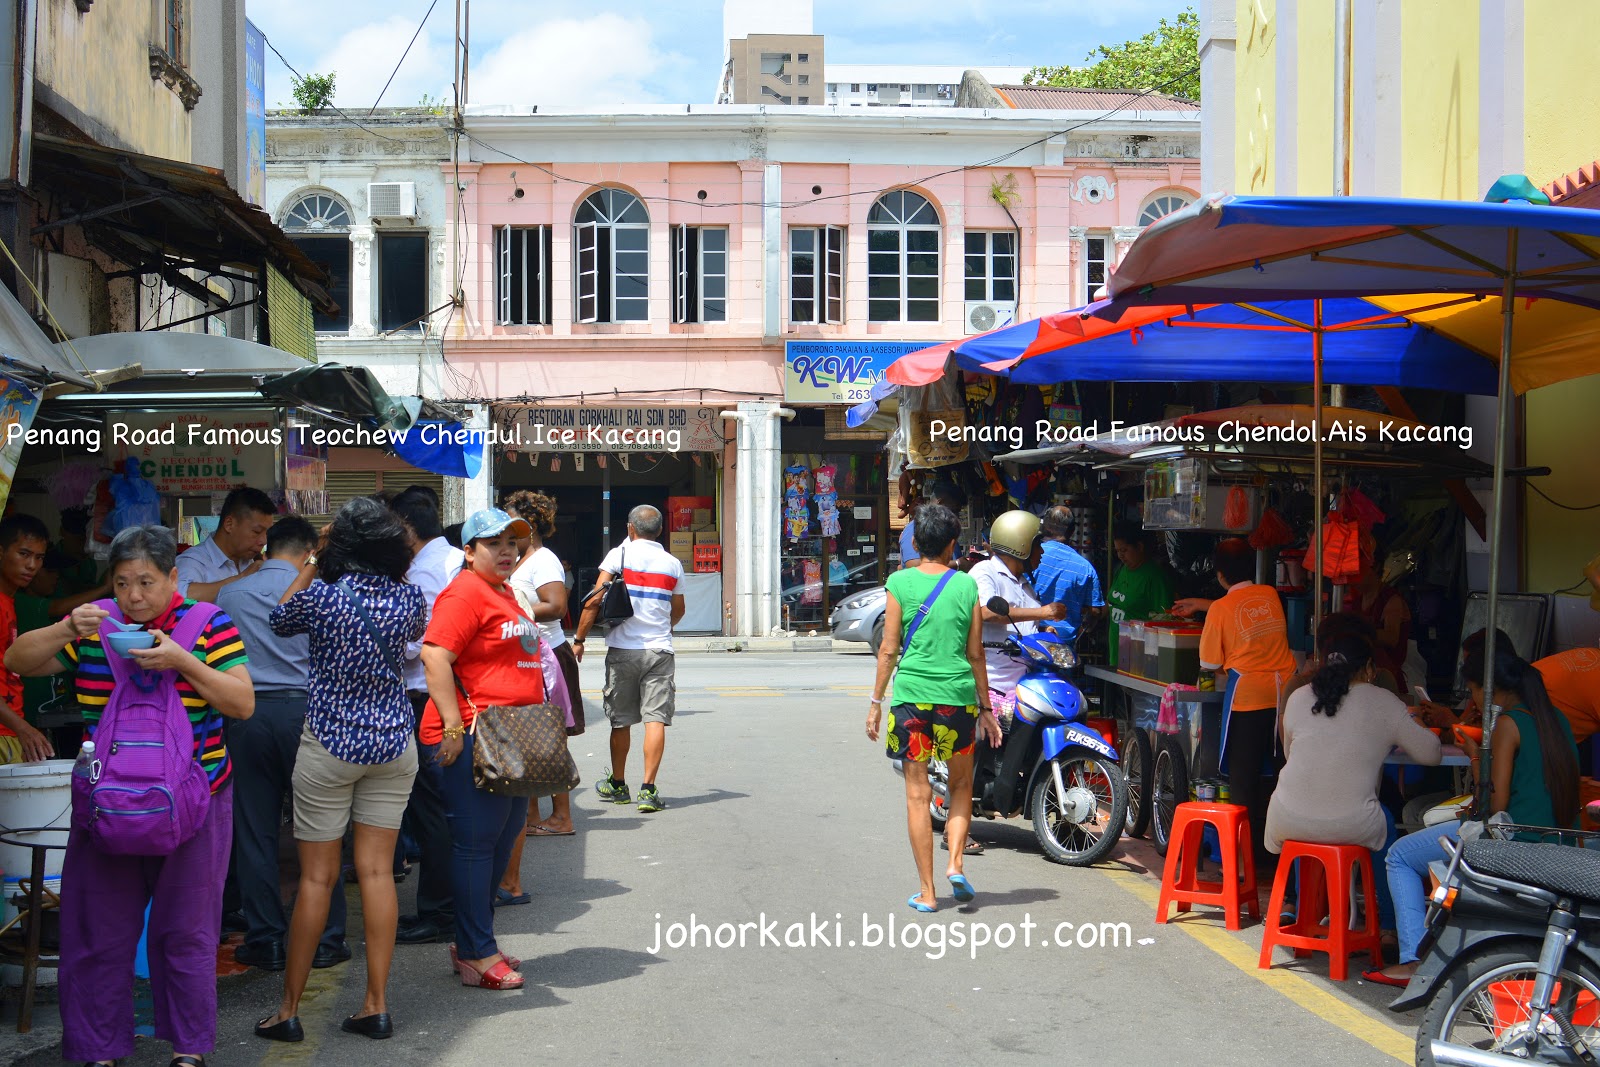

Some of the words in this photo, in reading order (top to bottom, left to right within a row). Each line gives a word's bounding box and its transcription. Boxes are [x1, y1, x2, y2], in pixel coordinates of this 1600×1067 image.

[792, 345, 834, 354] PEMBORONG
[835, 345, 863, 354] PAKAIAN
[864, 346, 870, 354] &
[871, 346, 902, 354] AKSESORI
[792, 355, 873, 389] KW
[177, 414, 209, 424] ROAD
[528, 409, 575, 426] RESTORAN
[579, 409, 623, 426] GORKHALI
[626, 409, 642, 426] RAI
[646, 409, 664, 426] SDN
[668, 409, 687, 425] BHD
[140, 458, 245, 478] CHENDUL
[161, 457, 226, 466] TEOCHEW
